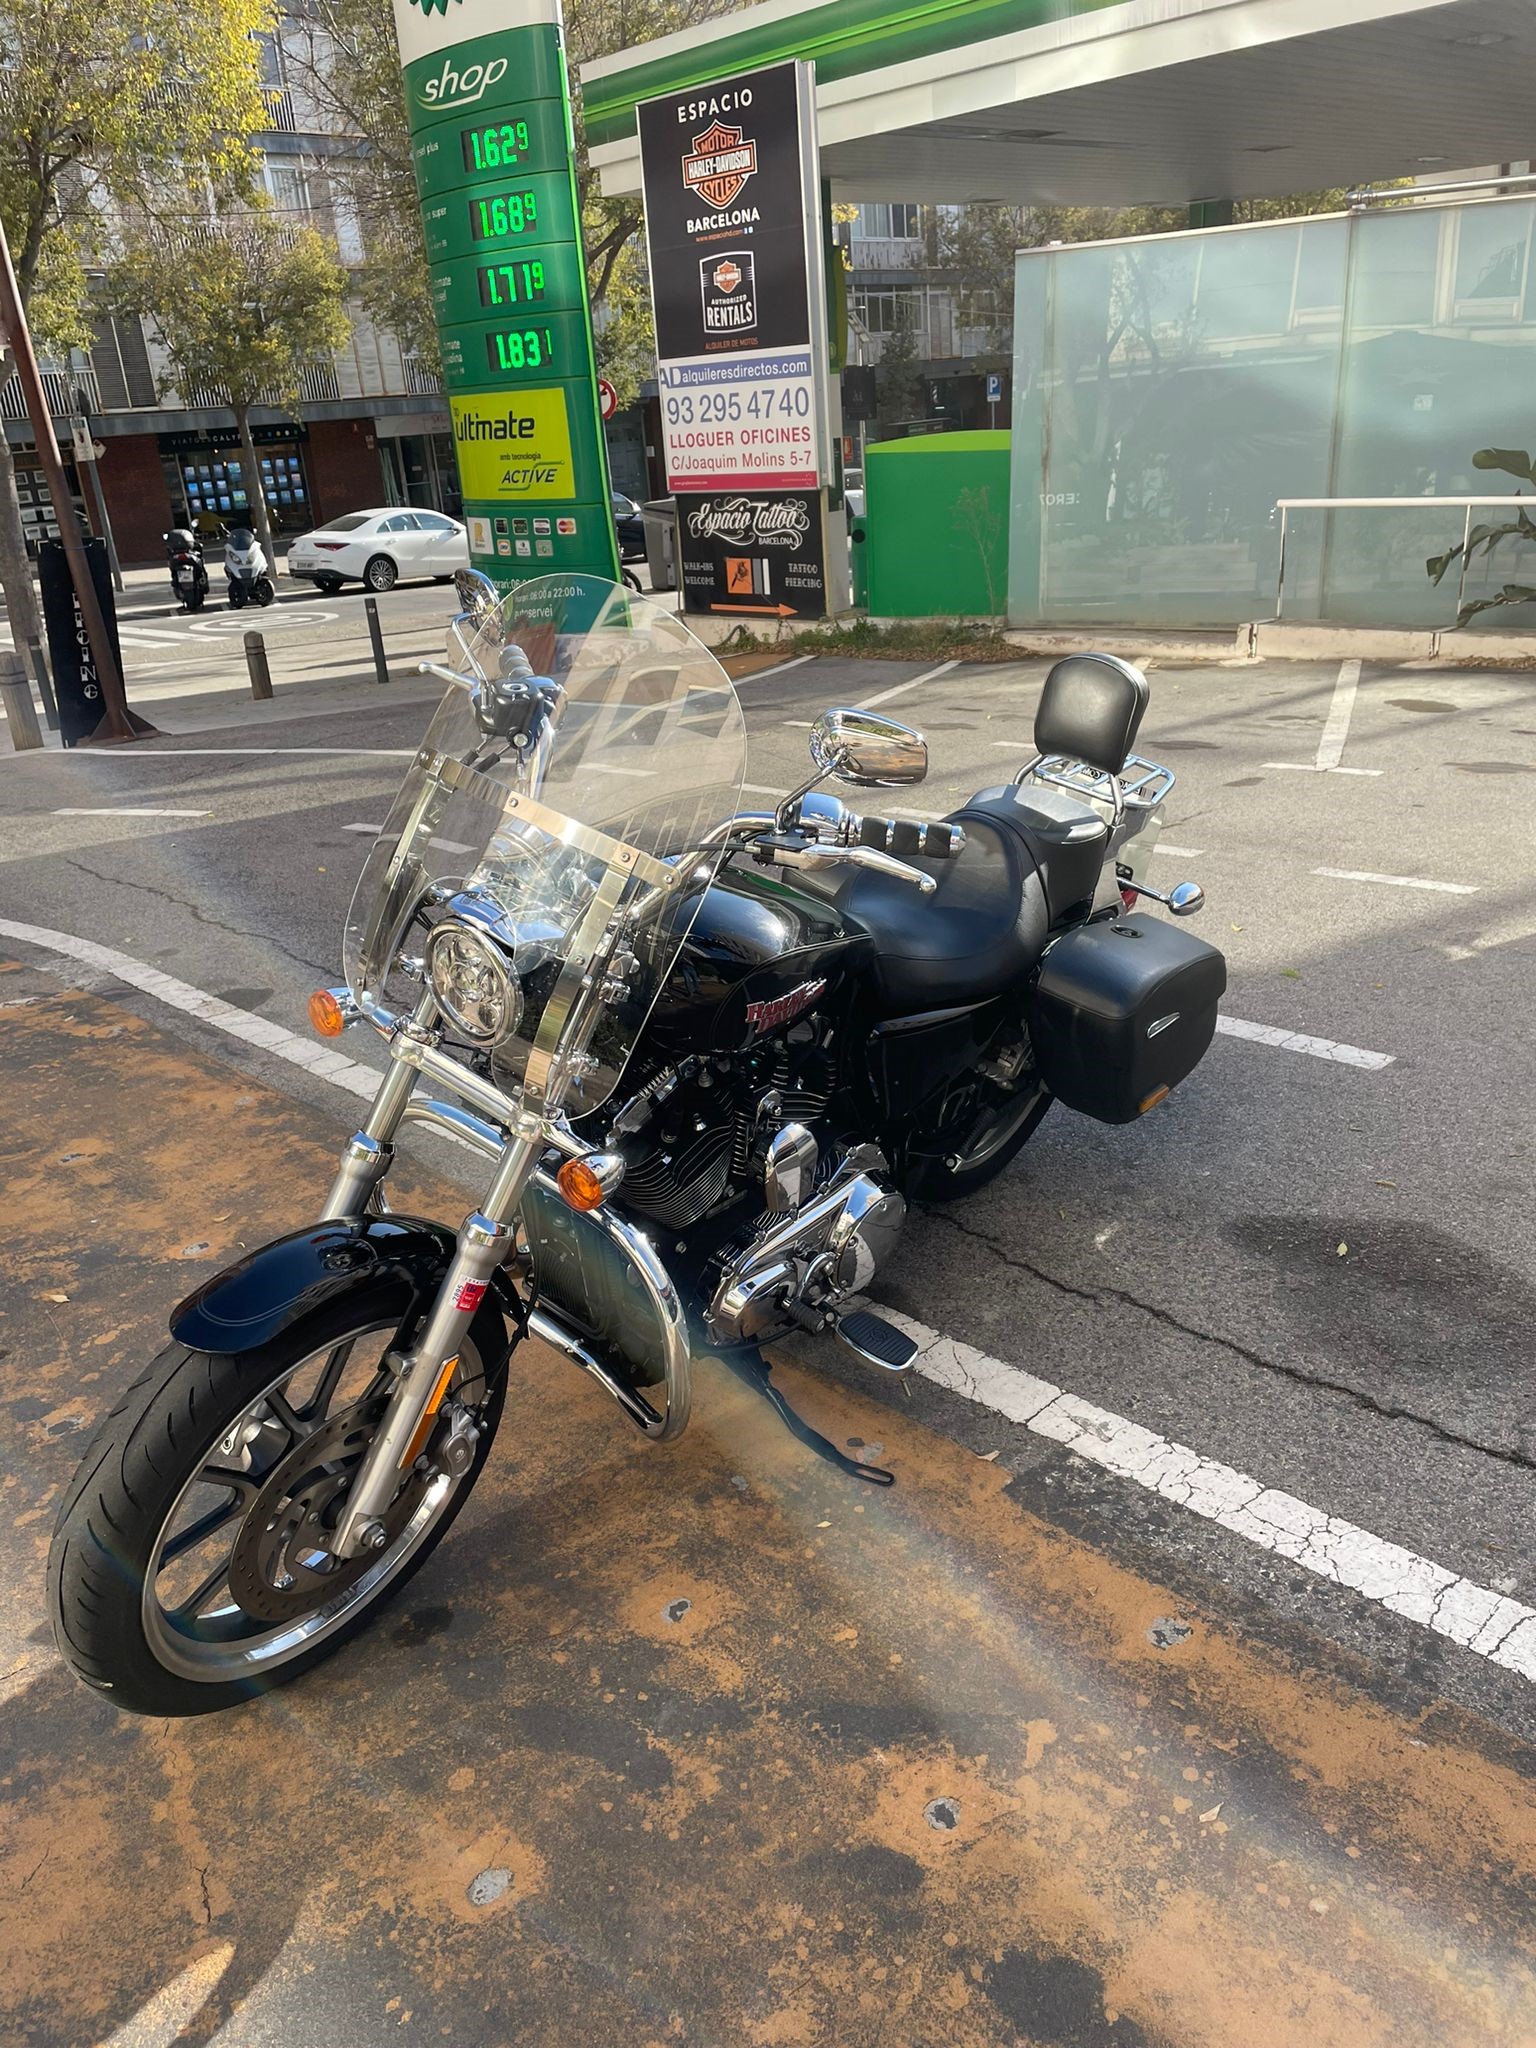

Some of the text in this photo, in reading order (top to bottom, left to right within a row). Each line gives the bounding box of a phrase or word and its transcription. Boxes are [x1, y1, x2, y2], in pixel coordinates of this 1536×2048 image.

[424, 58, 508, 101] shop
[677, 88, 753, 124] ESPACIO
[471, 122, 529, 170] 1.629
[700, 130, 735, 154] MOTOR
[687, 149, 752, 180] HARLEY-DAVIDSON
[703, 176, 738, 201] CYCLES
[479, 192, 537, 238] 1.689
[686, 206, 761, 234] BARCELONA
[711, 294, 747, 305] AUTHORIZED
[706, 301, 753, 327] RENTALS
[682, 360, 808, 385] alquileresdirectos.com
[667, 396, 694, 425] 93
[699, 392, 741, 423] 295
[212, 432, 255, 443] CALYPO
[670, 426, 811, 449] LLOGUER OFICINES
[671, 450, 812, 472] C/Joaquim Molins 5-7
[502, 468, 557, 484] ACTIVE
[758, 537, 794, 545] BARCELONA
[788, 563, 818, 574] TATTOO
[553, 586, 575, 598] 22:00
